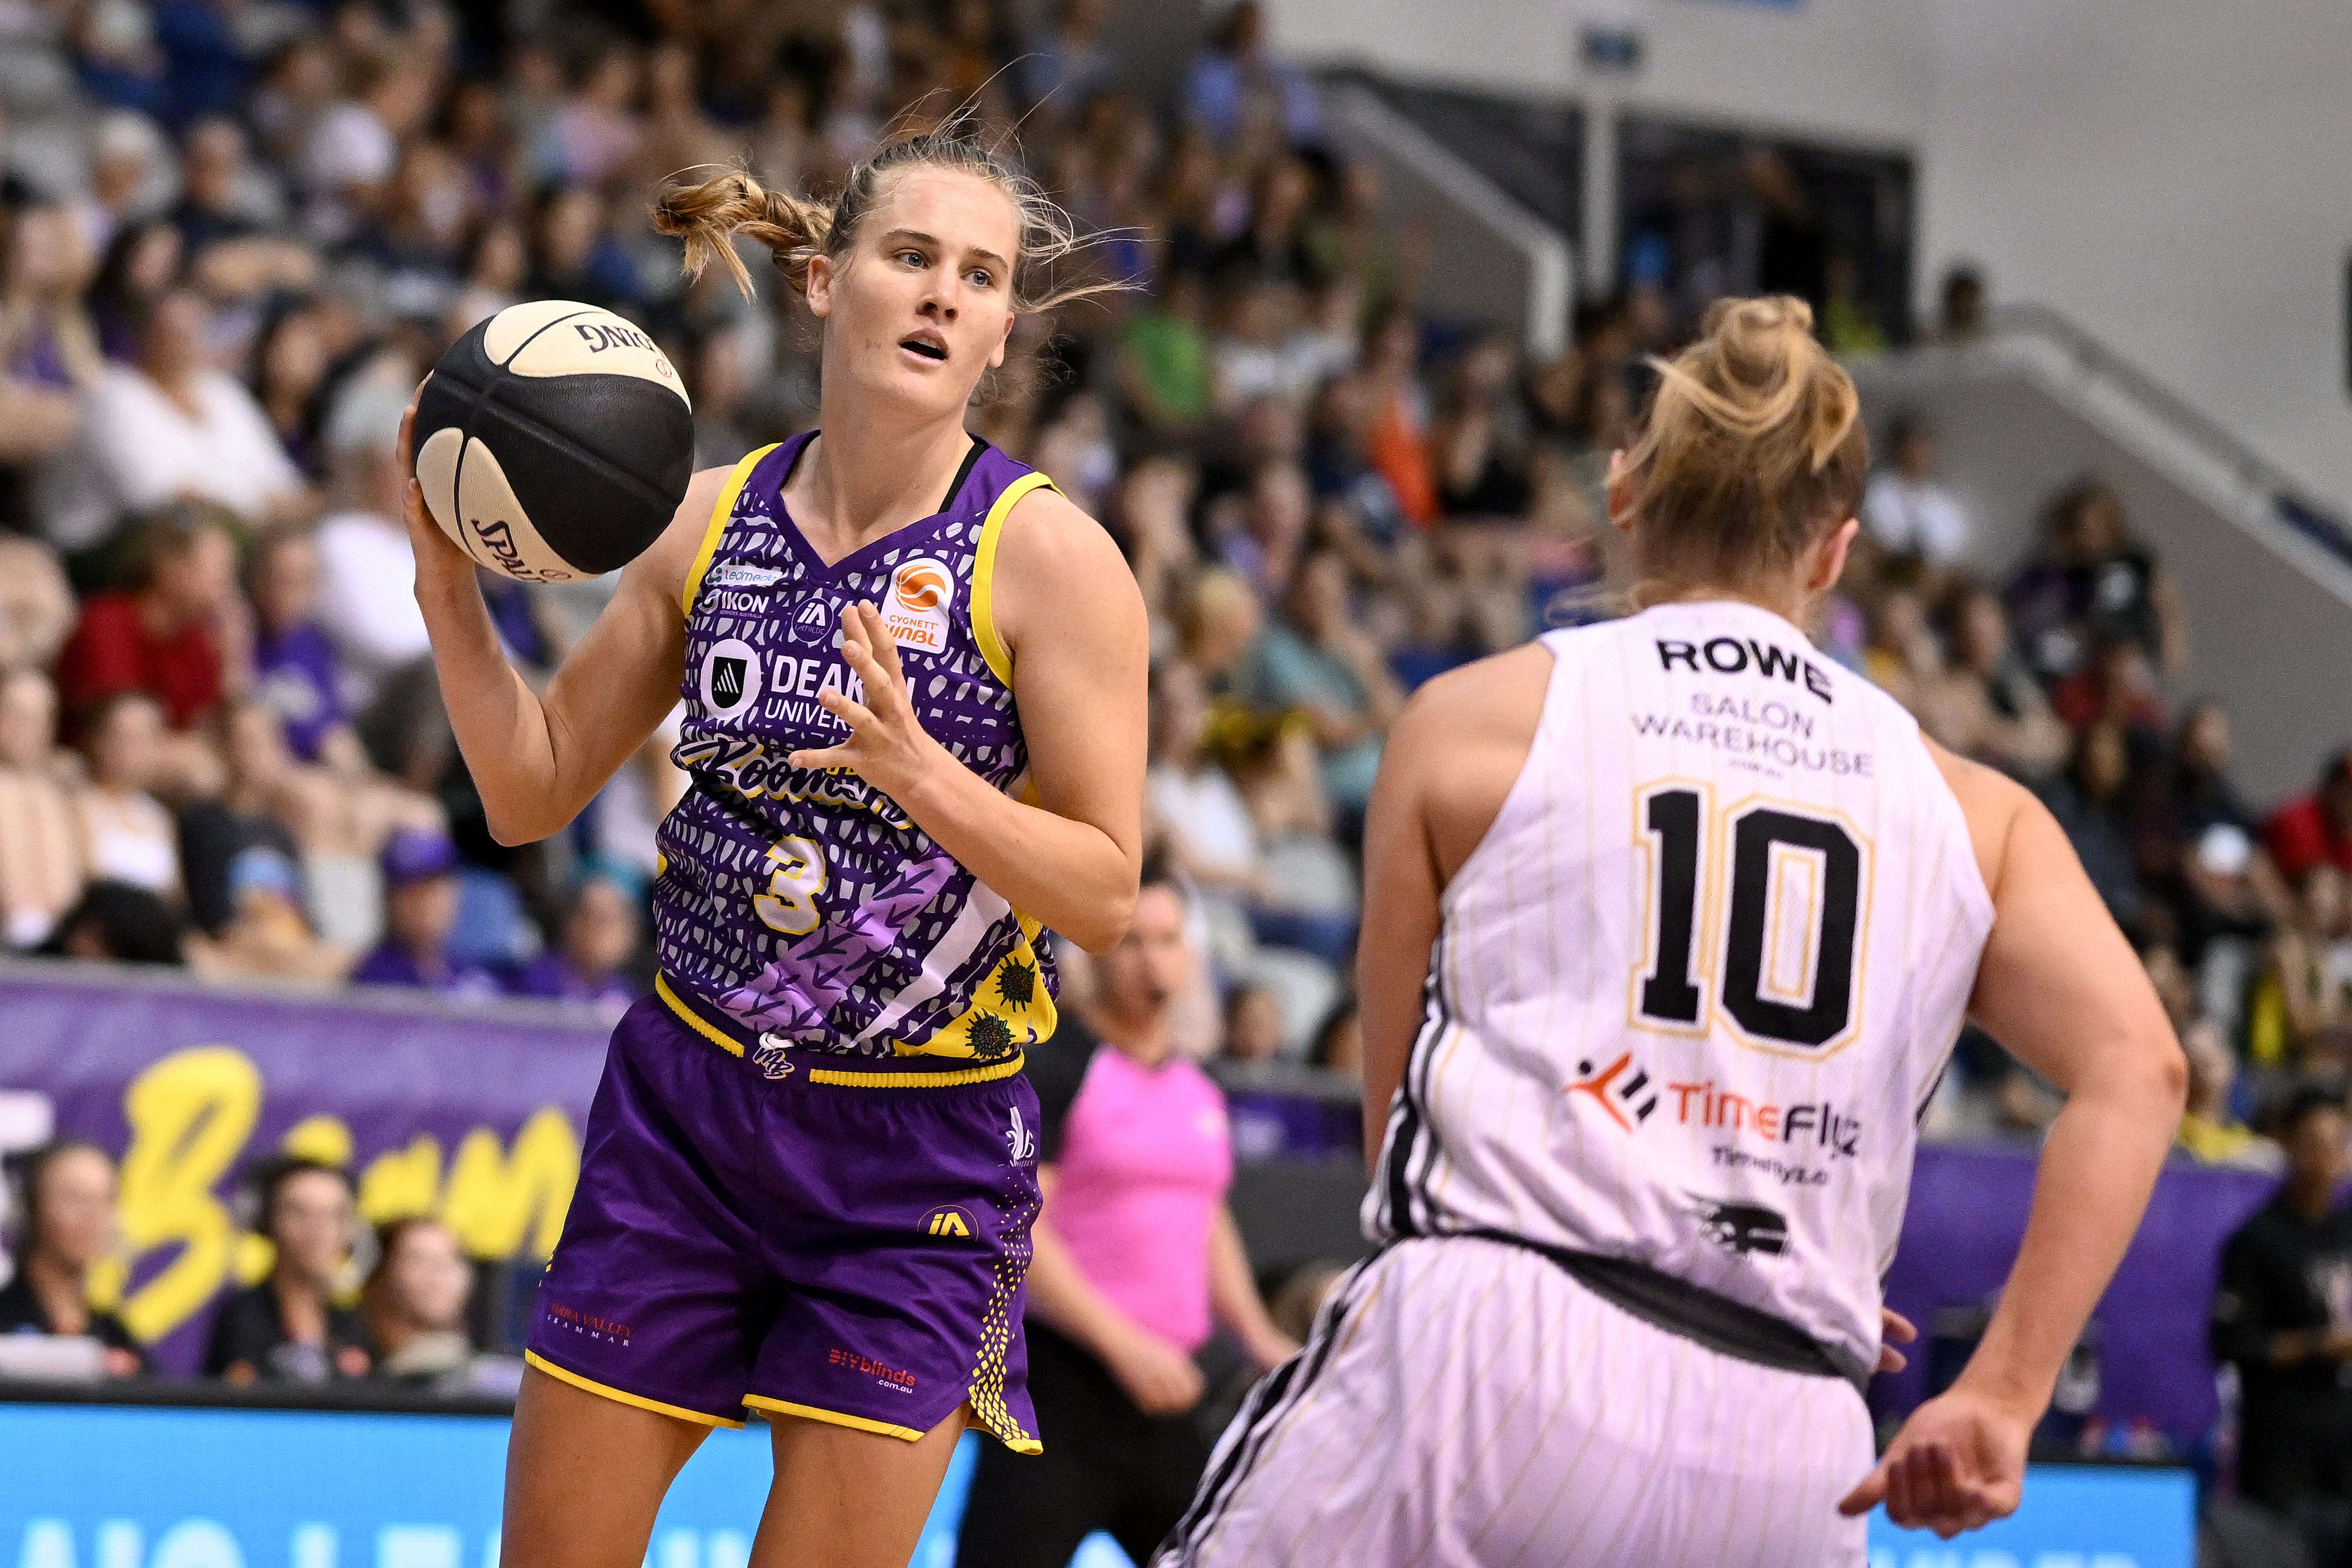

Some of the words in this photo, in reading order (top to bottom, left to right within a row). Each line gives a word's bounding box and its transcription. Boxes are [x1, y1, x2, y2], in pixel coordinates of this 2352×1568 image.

[574, 325, 656, 353] DING
[721, 591, 770, 614] IKON
[889, 615, 939, 630] CYGNETT
[771, 655, 916, 706] DEAK
[1656, 636, 1832, 705] ROWE
[765, 698, 854, 732] UNIVER
[1690, 691, 1814, 739] SALON
[1630, 712, 1874, 778] WAREHOUSE
[754, 836, 827, 936] 3
[1639, 788, 1861, 1049] 10
[547, 1314, 629, 1347] GRAMMAR
[876, 1379, 913, 1394] .com.au
